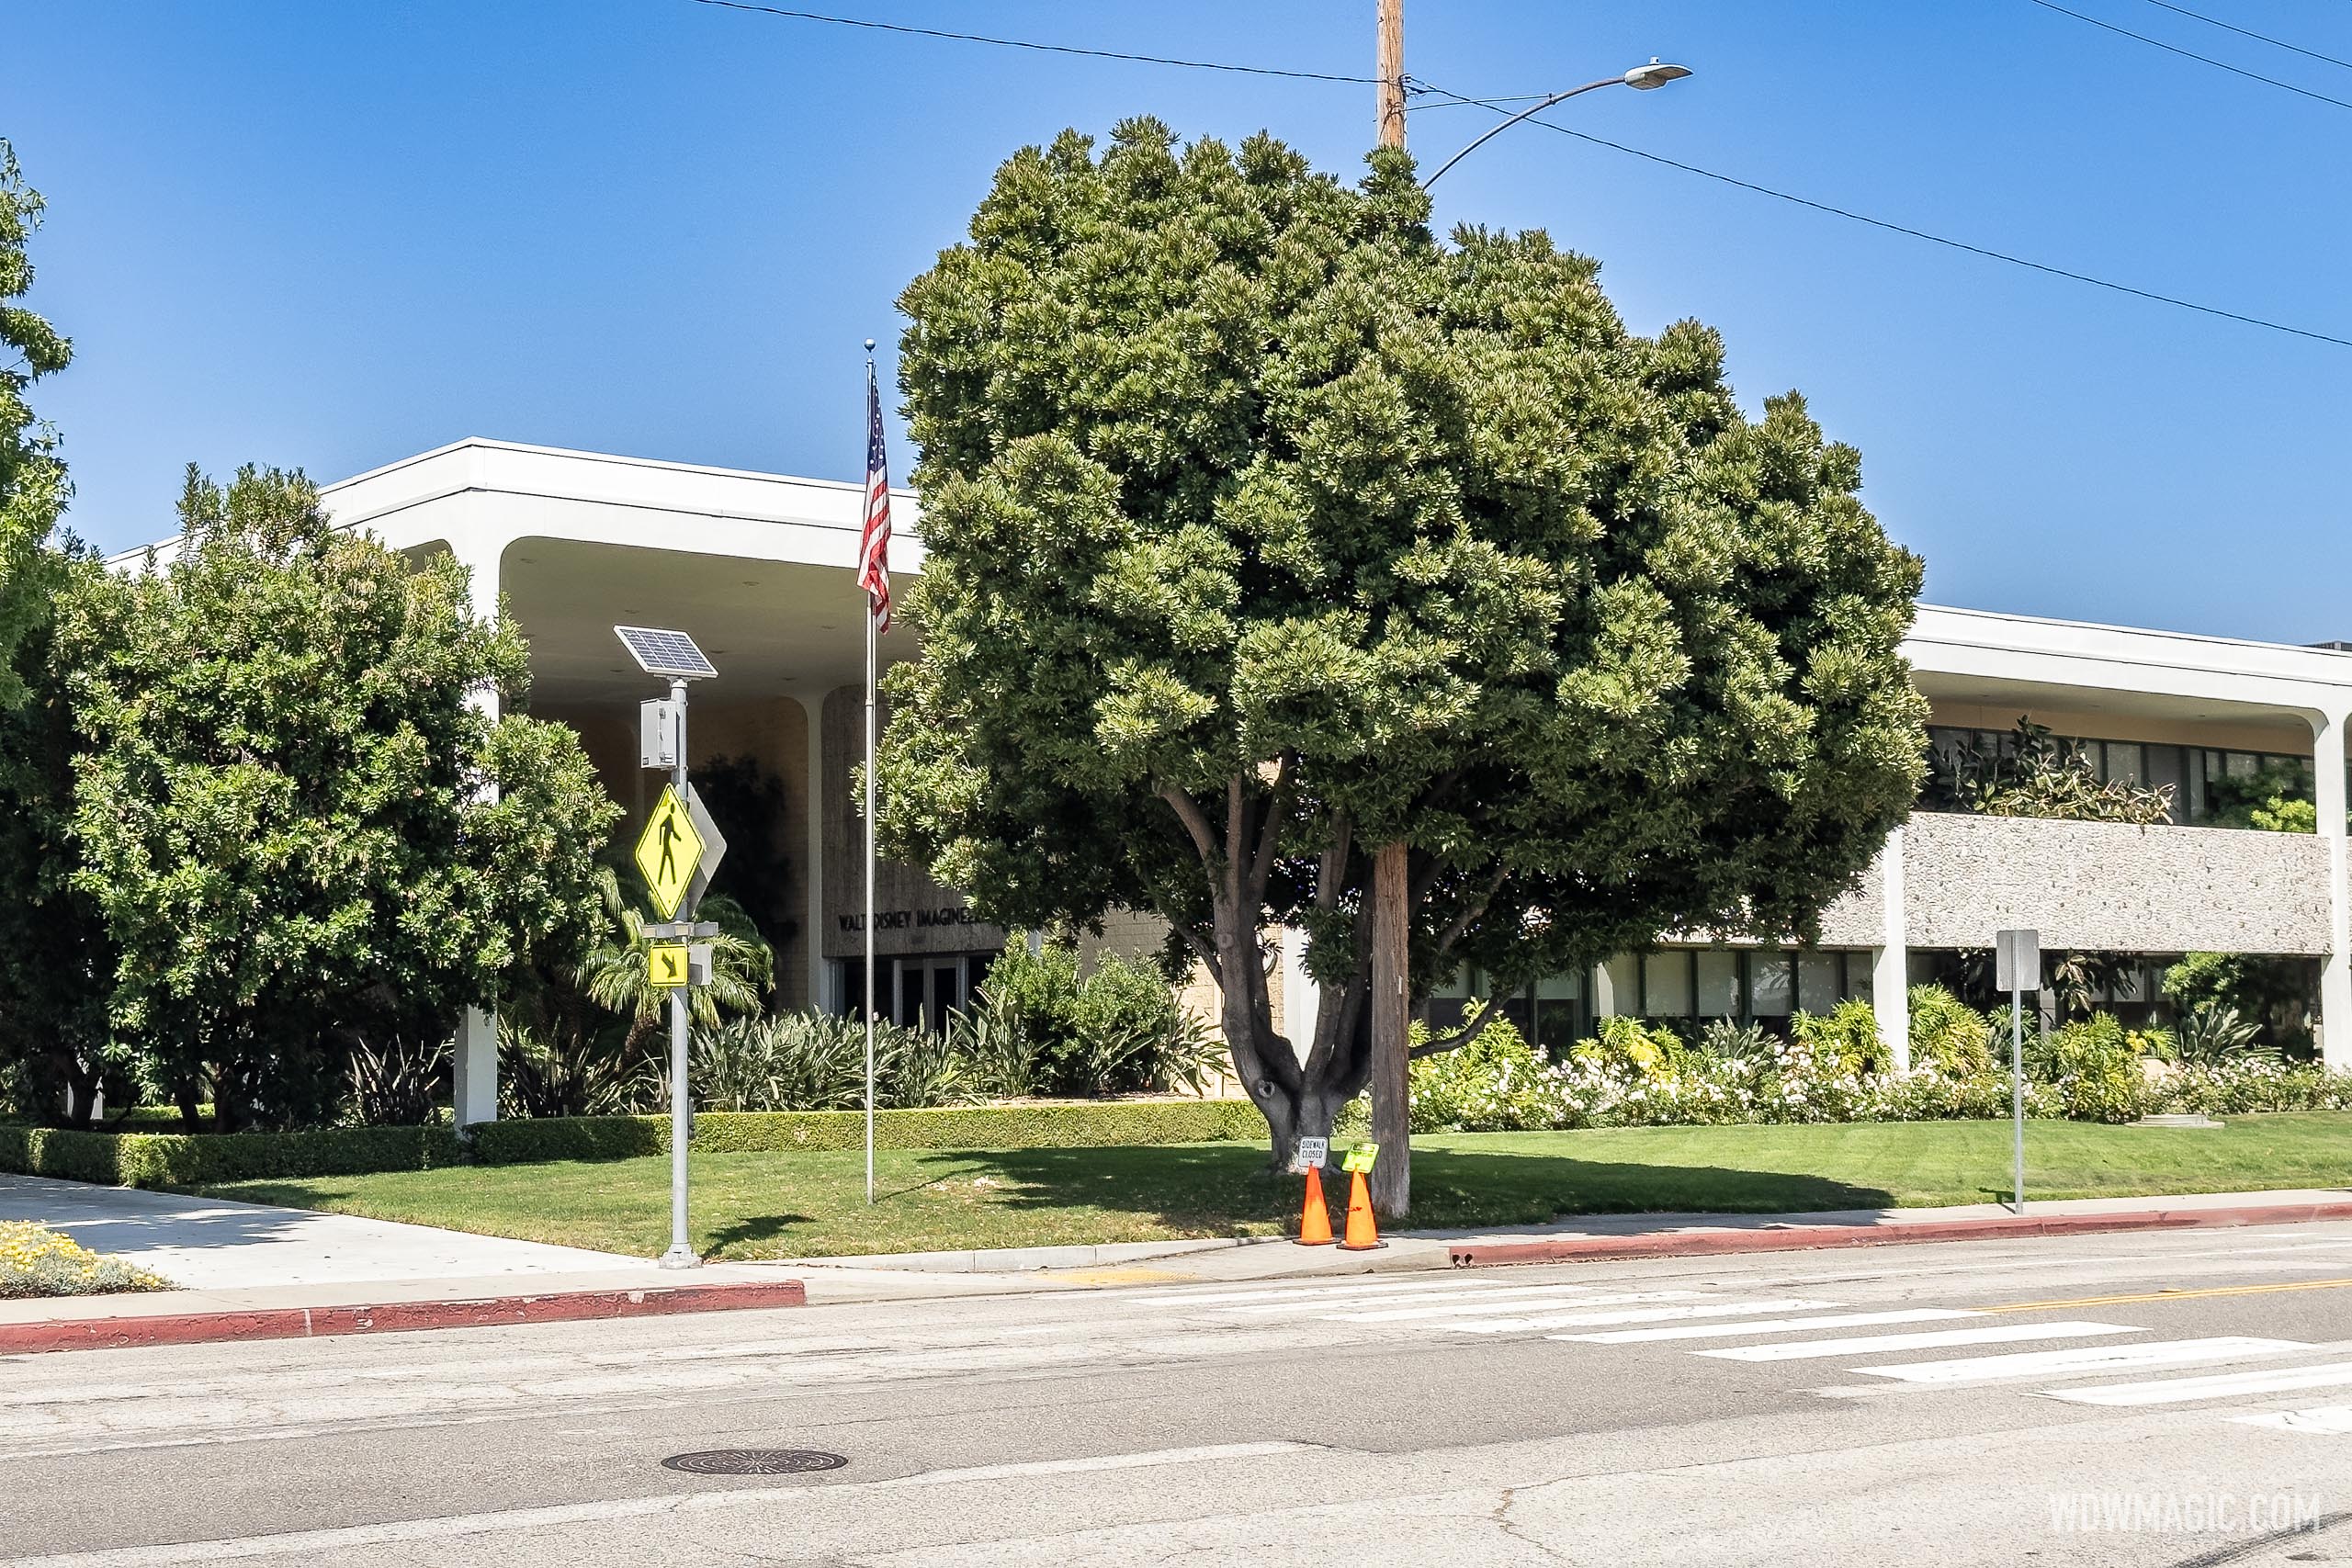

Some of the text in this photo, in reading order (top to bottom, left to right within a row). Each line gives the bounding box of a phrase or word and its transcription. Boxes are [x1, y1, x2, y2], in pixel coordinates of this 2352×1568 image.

[874, 910, 911, 929] DISNEY
[1301, 1139, 1325, 1149] SIDEWALK
[1302, 1150, 1323, 1159] CLOSED
